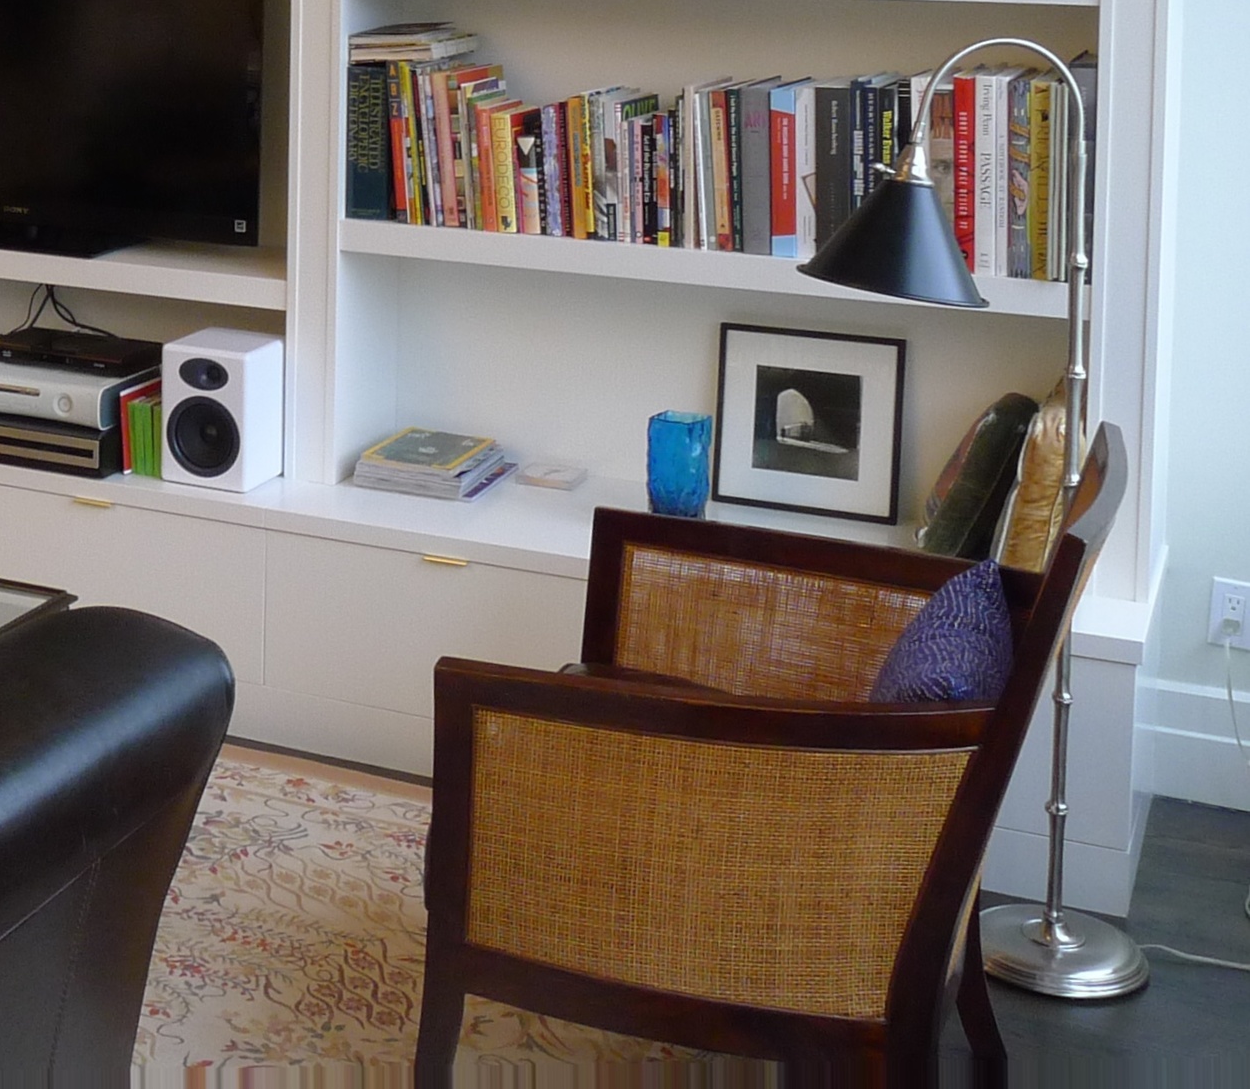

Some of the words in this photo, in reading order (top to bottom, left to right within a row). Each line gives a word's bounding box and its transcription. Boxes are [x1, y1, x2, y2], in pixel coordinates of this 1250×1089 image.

[389, 64, 397, 77] A
[390, 83, 398, 96] B
[980, 84, 993, 111] Irving
[349, 81, 359, 162] DICTIONARY
[391, 103, 399, 116] Z
[357, 74, 369, 173] ENCYCLOPEDIC
[370, 78, 383, 169] ILLUSTRATED
[882, 111, 893, 138] Walker
[981, 113, 992, 136] Penn
[643, 134, 651, 144] Art
[882, 140, 892, 164] Evans
[493, 117, 510, 209] EURODECO
[643, 152, 651, 162] the
[643, 163, 651, 191] Byzantine
[979, 152, 992, 209] PASSAGE
